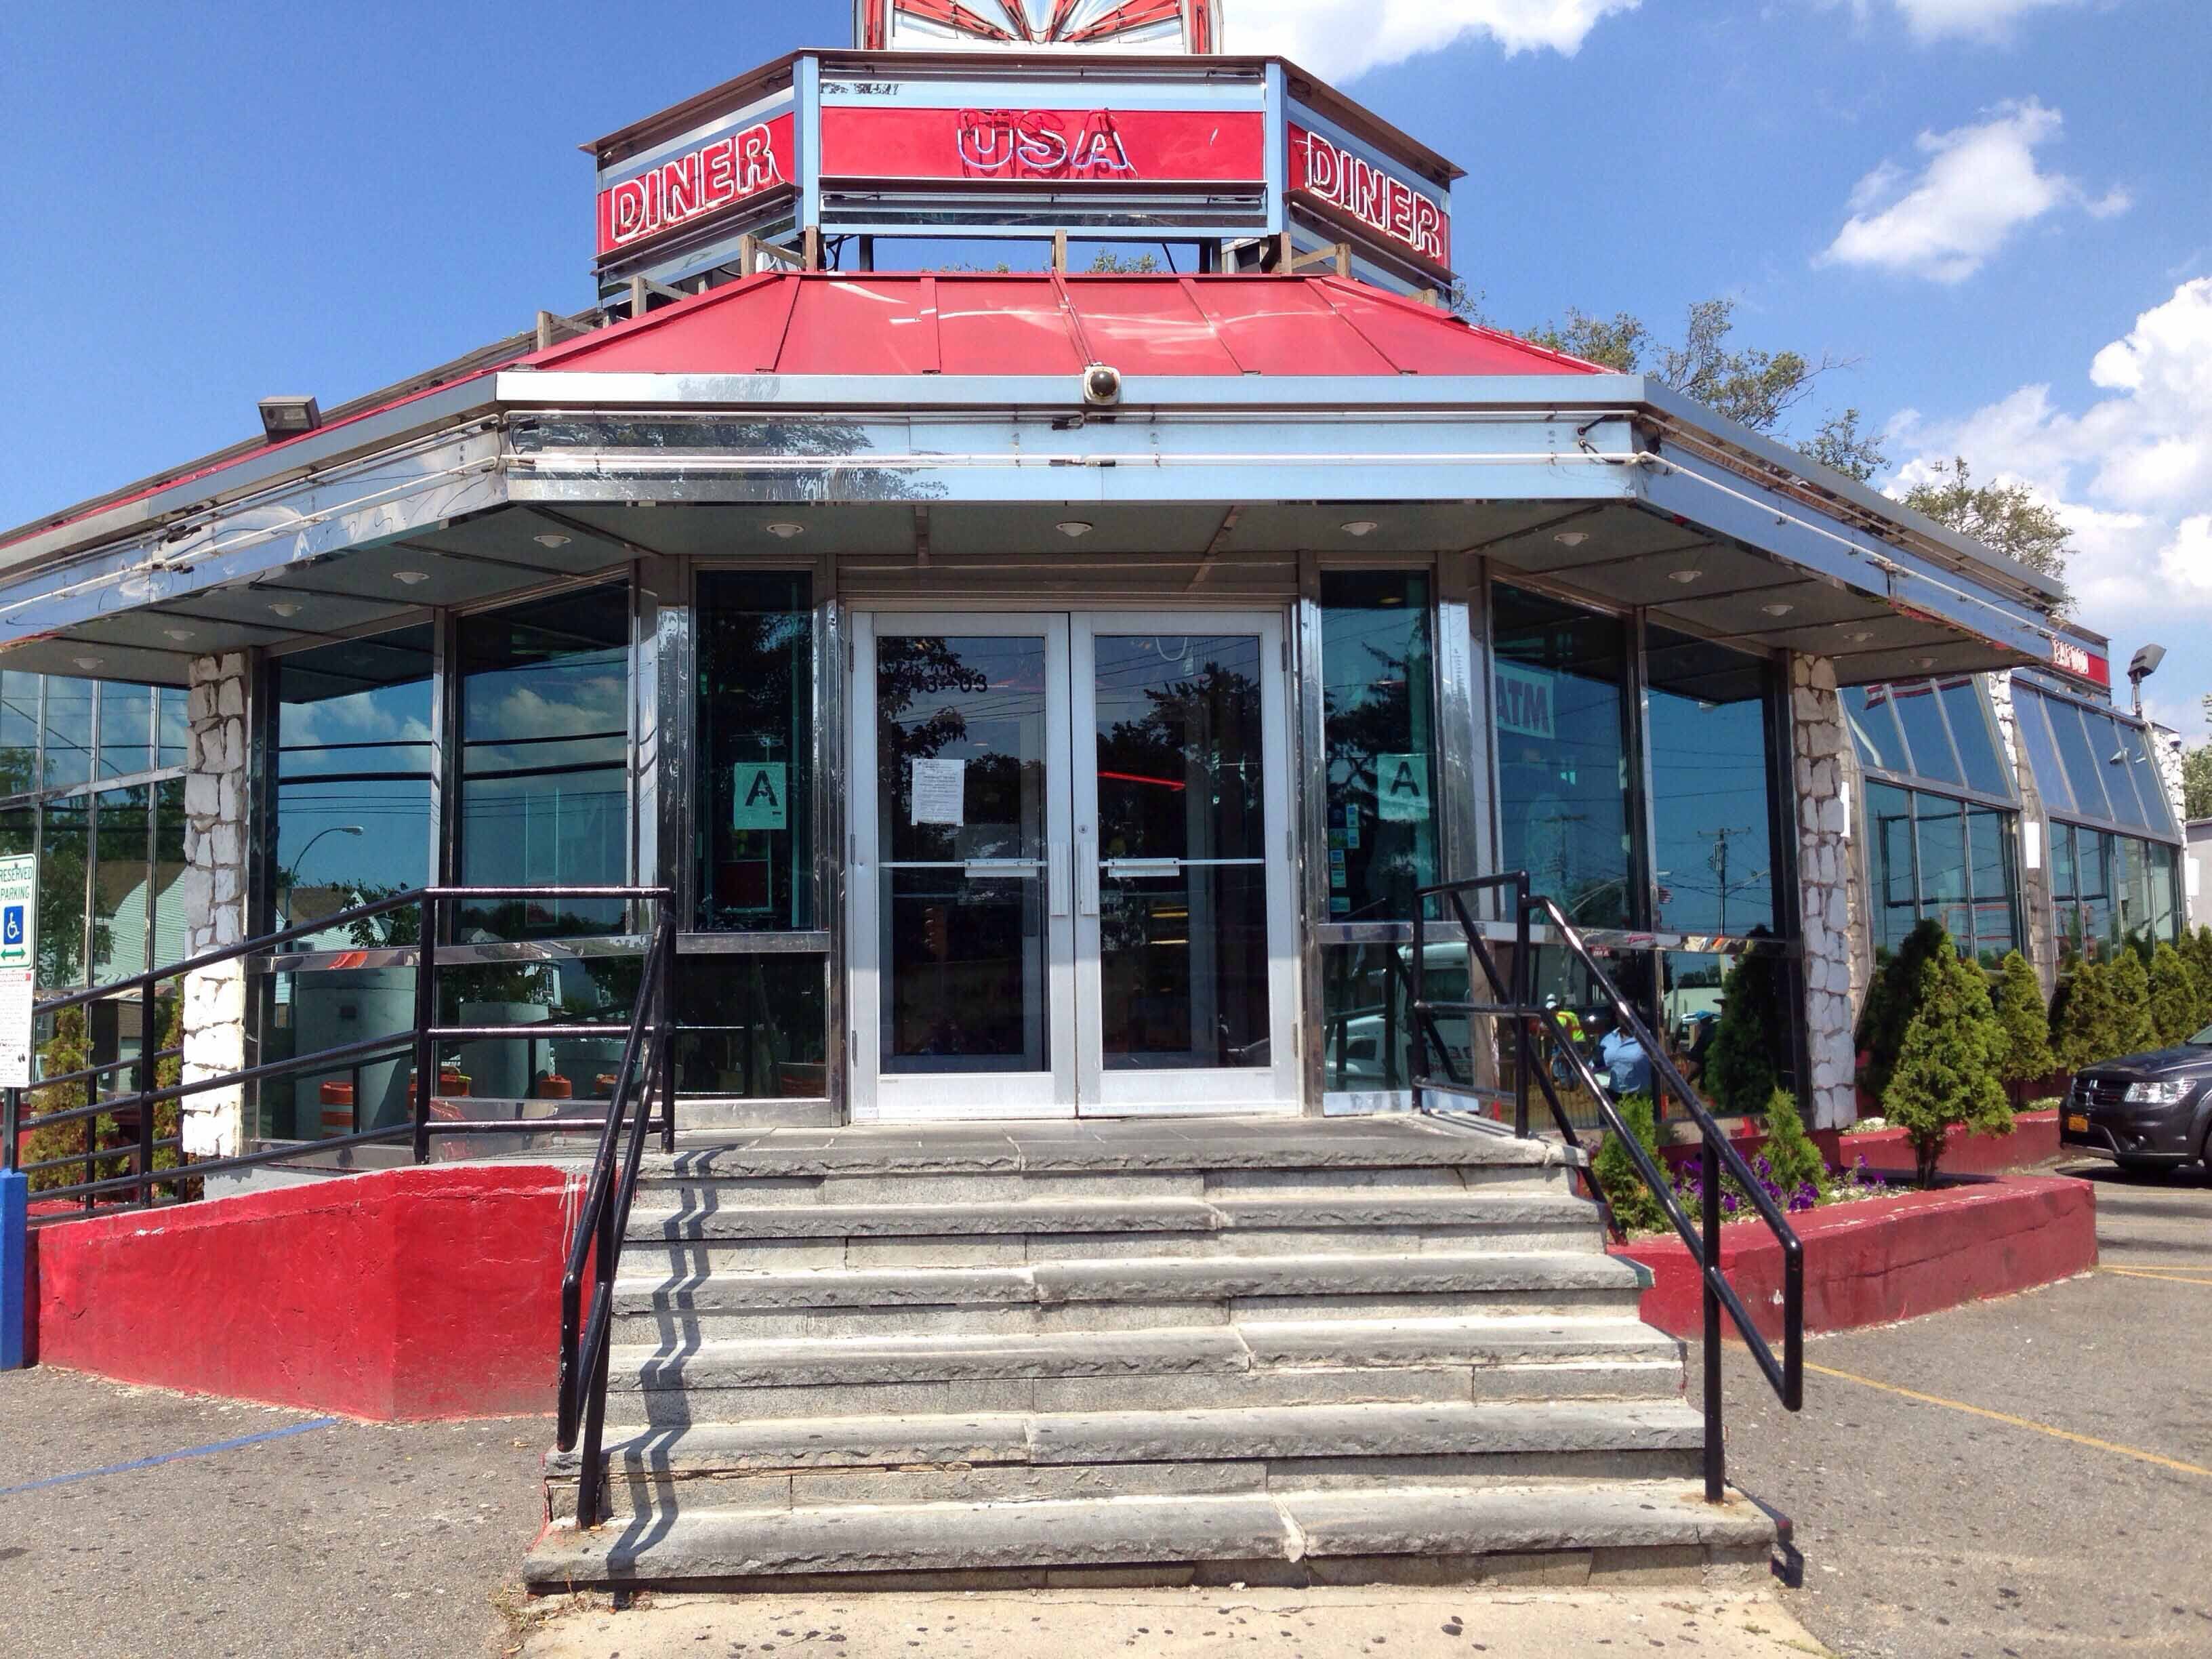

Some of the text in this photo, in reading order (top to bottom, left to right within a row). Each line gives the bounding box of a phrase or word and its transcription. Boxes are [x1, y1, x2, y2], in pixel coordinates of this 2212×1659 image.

[956, 108, 1132, 168] USA
[612, 123, 785, 243] DINER
[1307, 131, 1441, 258] DINER
[745, 770, 779, 806] A
[1390, 761, 1421, 796] A
[0, 865, 33, 882] RESERVED
[1, 885, 30, 901] PARKING
